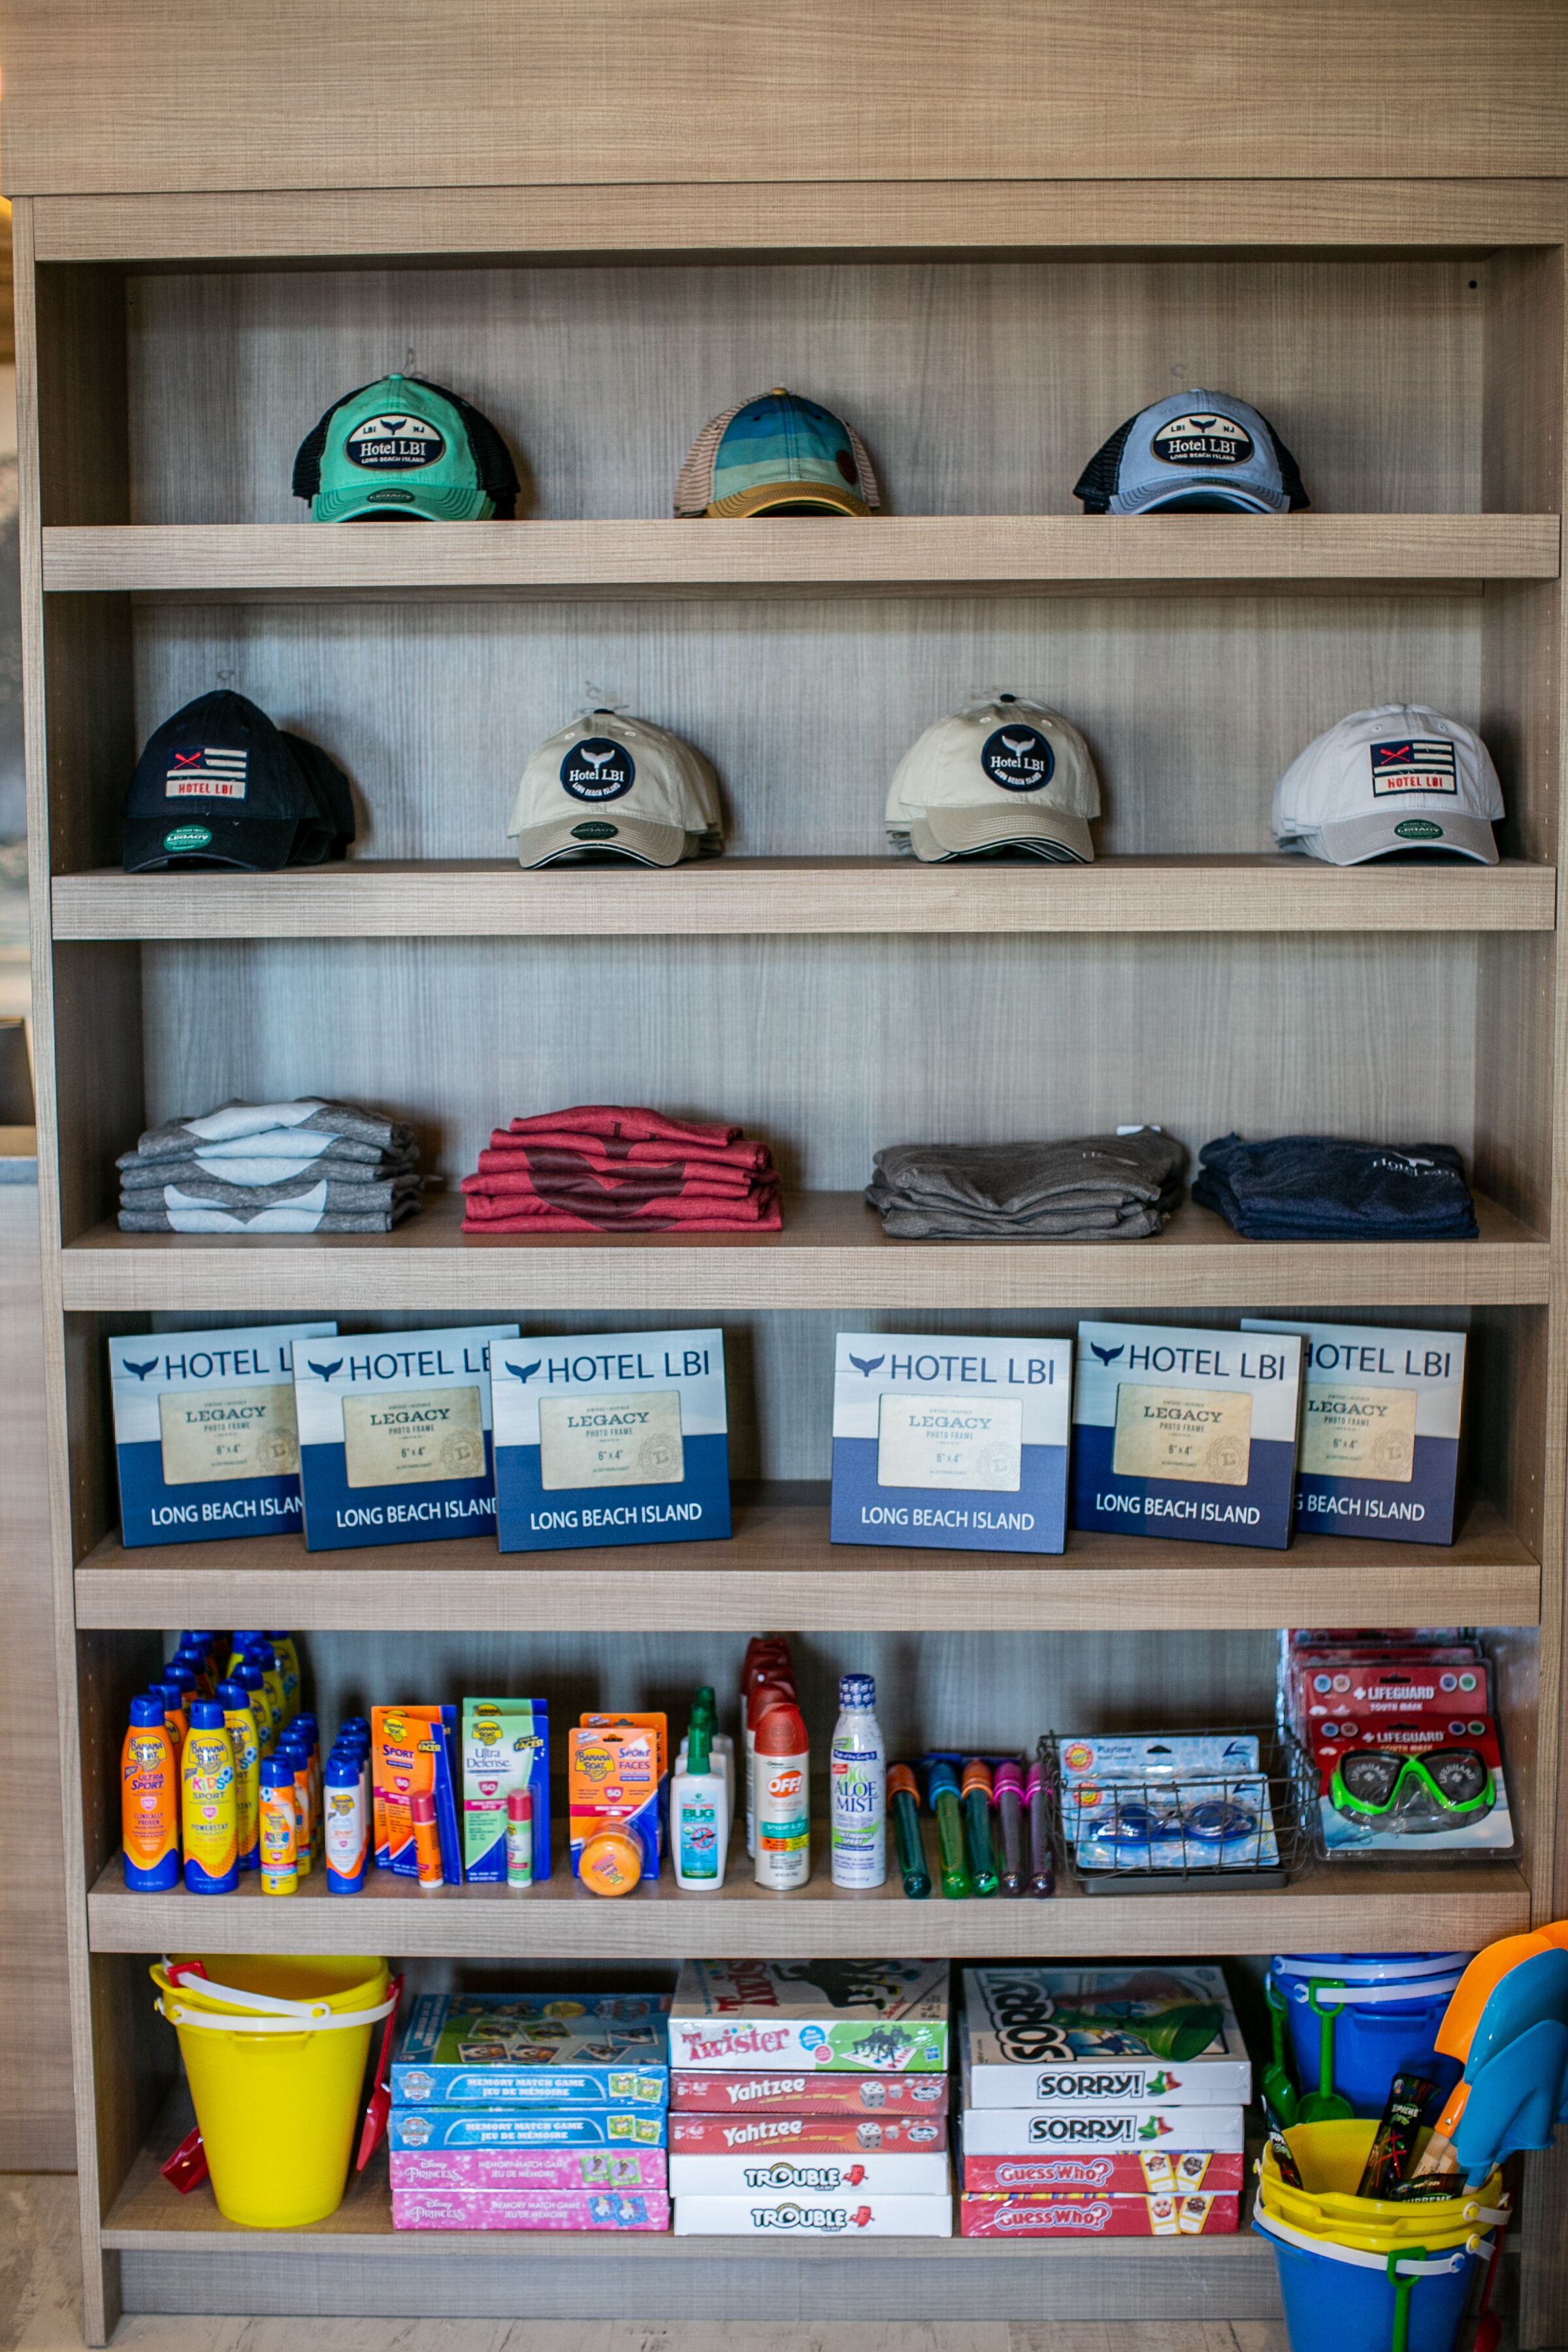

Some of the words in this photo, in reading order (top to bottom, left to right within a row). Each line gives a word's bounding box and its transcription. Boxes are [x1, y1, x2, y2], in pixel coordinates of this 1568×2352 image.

[359, 441, 396, 457] Hotel
[399, 441, 427, 455] LBI
[1168, 438, 1206, 453] Hotel
[1210, 438, 1237, 455] LBI
[990, 756, 1021, 768] Hotel
[1024, 757, 1045, 772] LBI
[569, 769, 599, 781] Hotel
[601, 769, 625, 782] LBI
[994, 768, 1007, 781] LONG
[1007, 776, 1025, 785] BEACH
[1025, 772, 1042, 785] ISLAND
[1388, 776, 1422, 789] HOTEL
[1426, 777, 1443, 787] LBI
[178, 783, 211, 794] HOTEL
[215, 784, 233, 794] LBI
[572, 782, 585, 794] LONG
[584, 789, 602, 797] BEACH
[602, 783, 621, 796] ISLAND
[165, 1348, 270, 1380] HOTEL
[350, 1350, 454, 1381] HOTEL
[548, 1354, 655, 1384] HOTEL
[664, 1350, 710, 1377] LBI
[891, 1354, 997, 1383] HOTEL
[1008, 1358, 1054, 1385] LBI
[1129, 1345, 1230, 1377] HOTEL
[1241, 1352, 1285, 1381] LBI
[1405, 1350, 1451, 1379] LBI
[186, 1406, 267, 1424] LEGACY
[1143, 1405, 1223, 1424] LEGACY
[1307, 1400, 1388, 1418] LEGACY
[370, 1409, 451, 1426] LEGACY
[567, 1412, 649, 1428] LEGACY
[909, 1415, 992, 1429] LEGACY
[1324, 1416, 1346, 1426] PHOTO
[1348, 1417, 1369, 1427] FRAME
[204, 1424, 226, 1432] PHOTO
[228, 1422, 250, 1430] FRAME
[389, 1426, 410, 1435] PHOTO
[413, 1424, 434, 1433] FRAME
[586, 1429, 608, 1437] PHOTO
[610, 1427, 633, 1436] FRAME
[926, 1430, 949, 1439] PHOTO
[951, 1431, 973, 1440] FRAME
[1160, 1422, 1181, 1431] PHOTO
[1183, 1424, 1205, 1433] FRAME
[151, 1505, 197, 1526] LONG
[203, 1499, 256, 1521] BEACH
[261, 1497, 303, 1516] ISLAN
[336, 1507, 384, 1528] LONG
[387, 1502, 441, 1524] BEACH
[531, 1511, 578, 1530] LONG
[582, 1507, 637, 1527] BEACH
[642, 1503, 702, 1522] ISLAND
[1096, 1493, 1141, 1514] LONG
[1145, 1497, 1197, 1520] BEACH
[1201, 1503, 1260, 1525] ISLAND
[1307, 1495, 1361, 1516] BEACH
[1365, 1499, 1426, 1522] ISLAND
[861, 1506, 908, 1525] LONG
[913, 1509, 968, 1527] BEACH
[973, 1511, 1034, 1531] ISLAND
[1368, 1687, 1435, 1700] LIFEGUARD
[1370, 1703, 1397, 1711] YOUTH
[515, 1739, 544, 1750] FACES!
[1377, 1733, 1445, 1743] LIFEGUARD
[383, 1744, 414, 1759] SPORT
[476, 1748, 500, 1758] Ultra
[578, 1751, 611, 1762] BANANA
[618, 1748, 651, 1759] SPORT
[466, 1758, 511, 1768] Defense
[584, 1762, 605, 1774] BOAT
[131, 1780, 163, 1790] SPORT
[767, 1774, 803, 1793] OFF!
[835, 1781, 877, 1797] ALOE
[836, 1797, 879, 1812] MIST
[683, 1808, 715, 1818] BUG
[682, 2028, 789, 2061] Twister
[518, 2087, 570, 2096] MÉMOIRE
[726, 2078, 806, 2104] Yahtzee
[1041, 2074, 1141, 2096] SORRY!
[1392, 2104, 1419, 2117] SUPREME
[517, 2131, 568, 2140] MÉMOIRE
[723, 2121, 803, 2147] Yahtzee
[1032, 2119, 1132, 2140] SORRY!
[744, 2166, 841, 2188] TROUBLE
[1000, 2164, 1055, 2181] Guess
[1056, 2160, 1111, 2186] Who?
[751, 2206, 847, 2229] TROUBLE
[998, 2208, 1052, 2227] Guess
[1052, 2204, 1110, 2230] Who?
